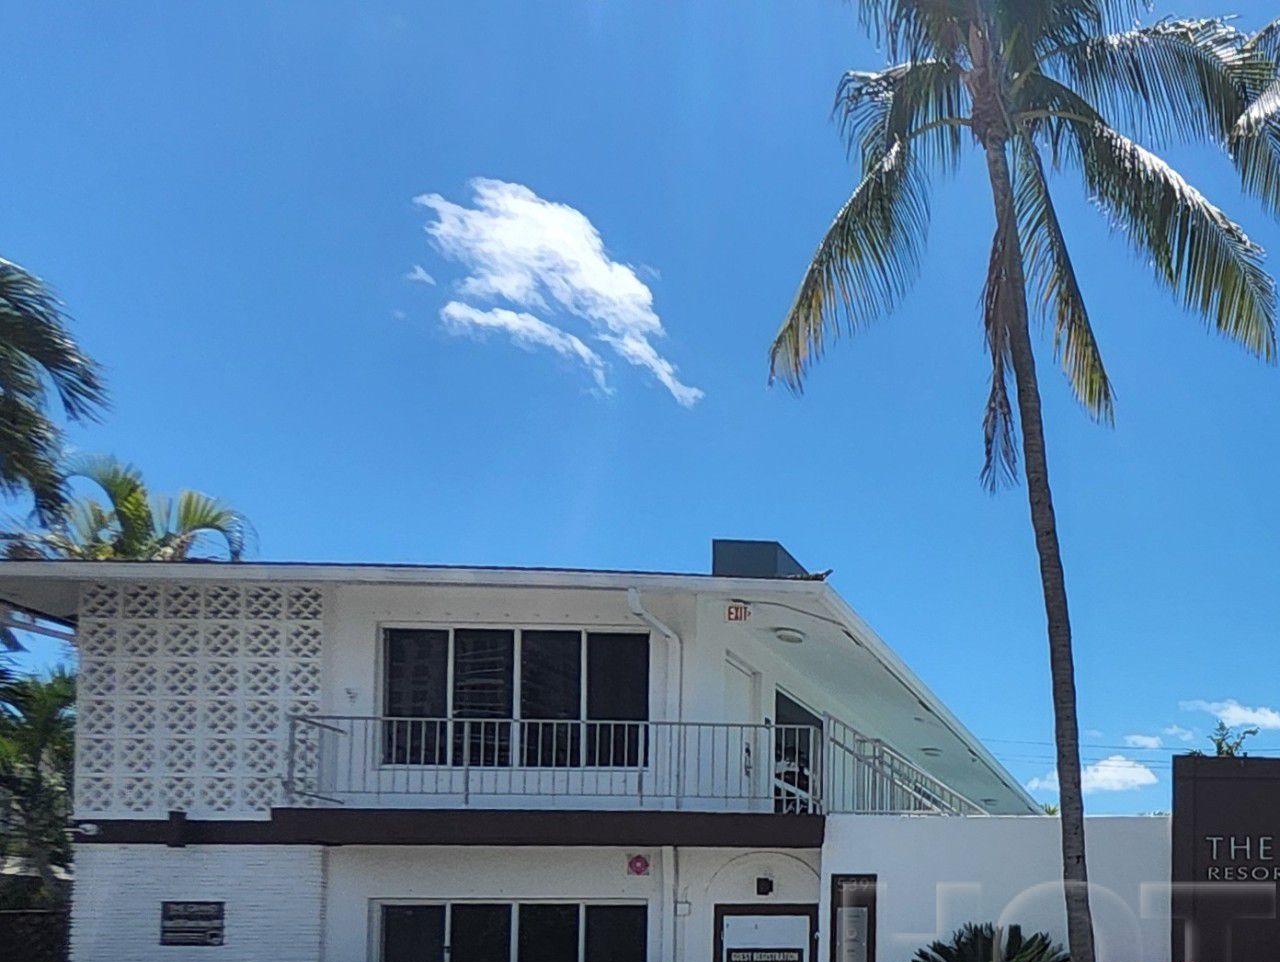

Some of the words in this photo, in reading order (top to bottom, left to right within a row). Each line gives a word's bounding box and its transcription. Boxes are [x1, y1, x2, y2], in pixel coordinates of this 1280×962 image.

[727, 605, 748, 621] EXIT
[1206, 837, 1273, 860] THE
[731, 952, 752, 961] GUEST
[753, 952, 798, 961] REGISTRATION
